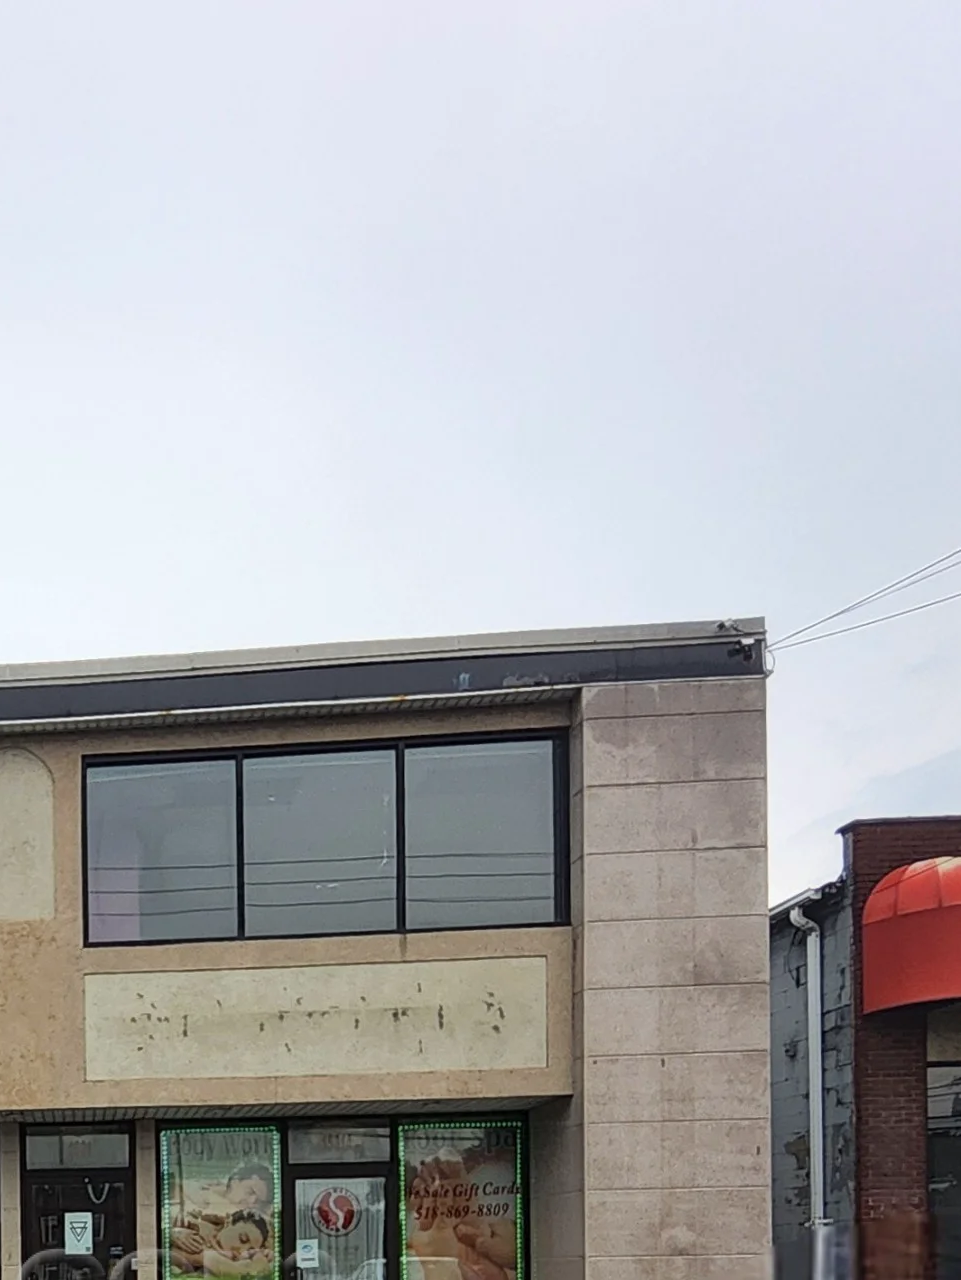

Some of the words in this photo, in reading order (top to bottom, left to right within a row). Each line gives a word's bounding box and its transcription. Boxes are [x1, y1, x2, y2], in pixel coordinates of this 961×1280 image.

[422, 1184, 450, 1199] Sale
[453, 1182, 480, 1201] Gift
[414, 1203, 511, 1220] 518-869-8809
